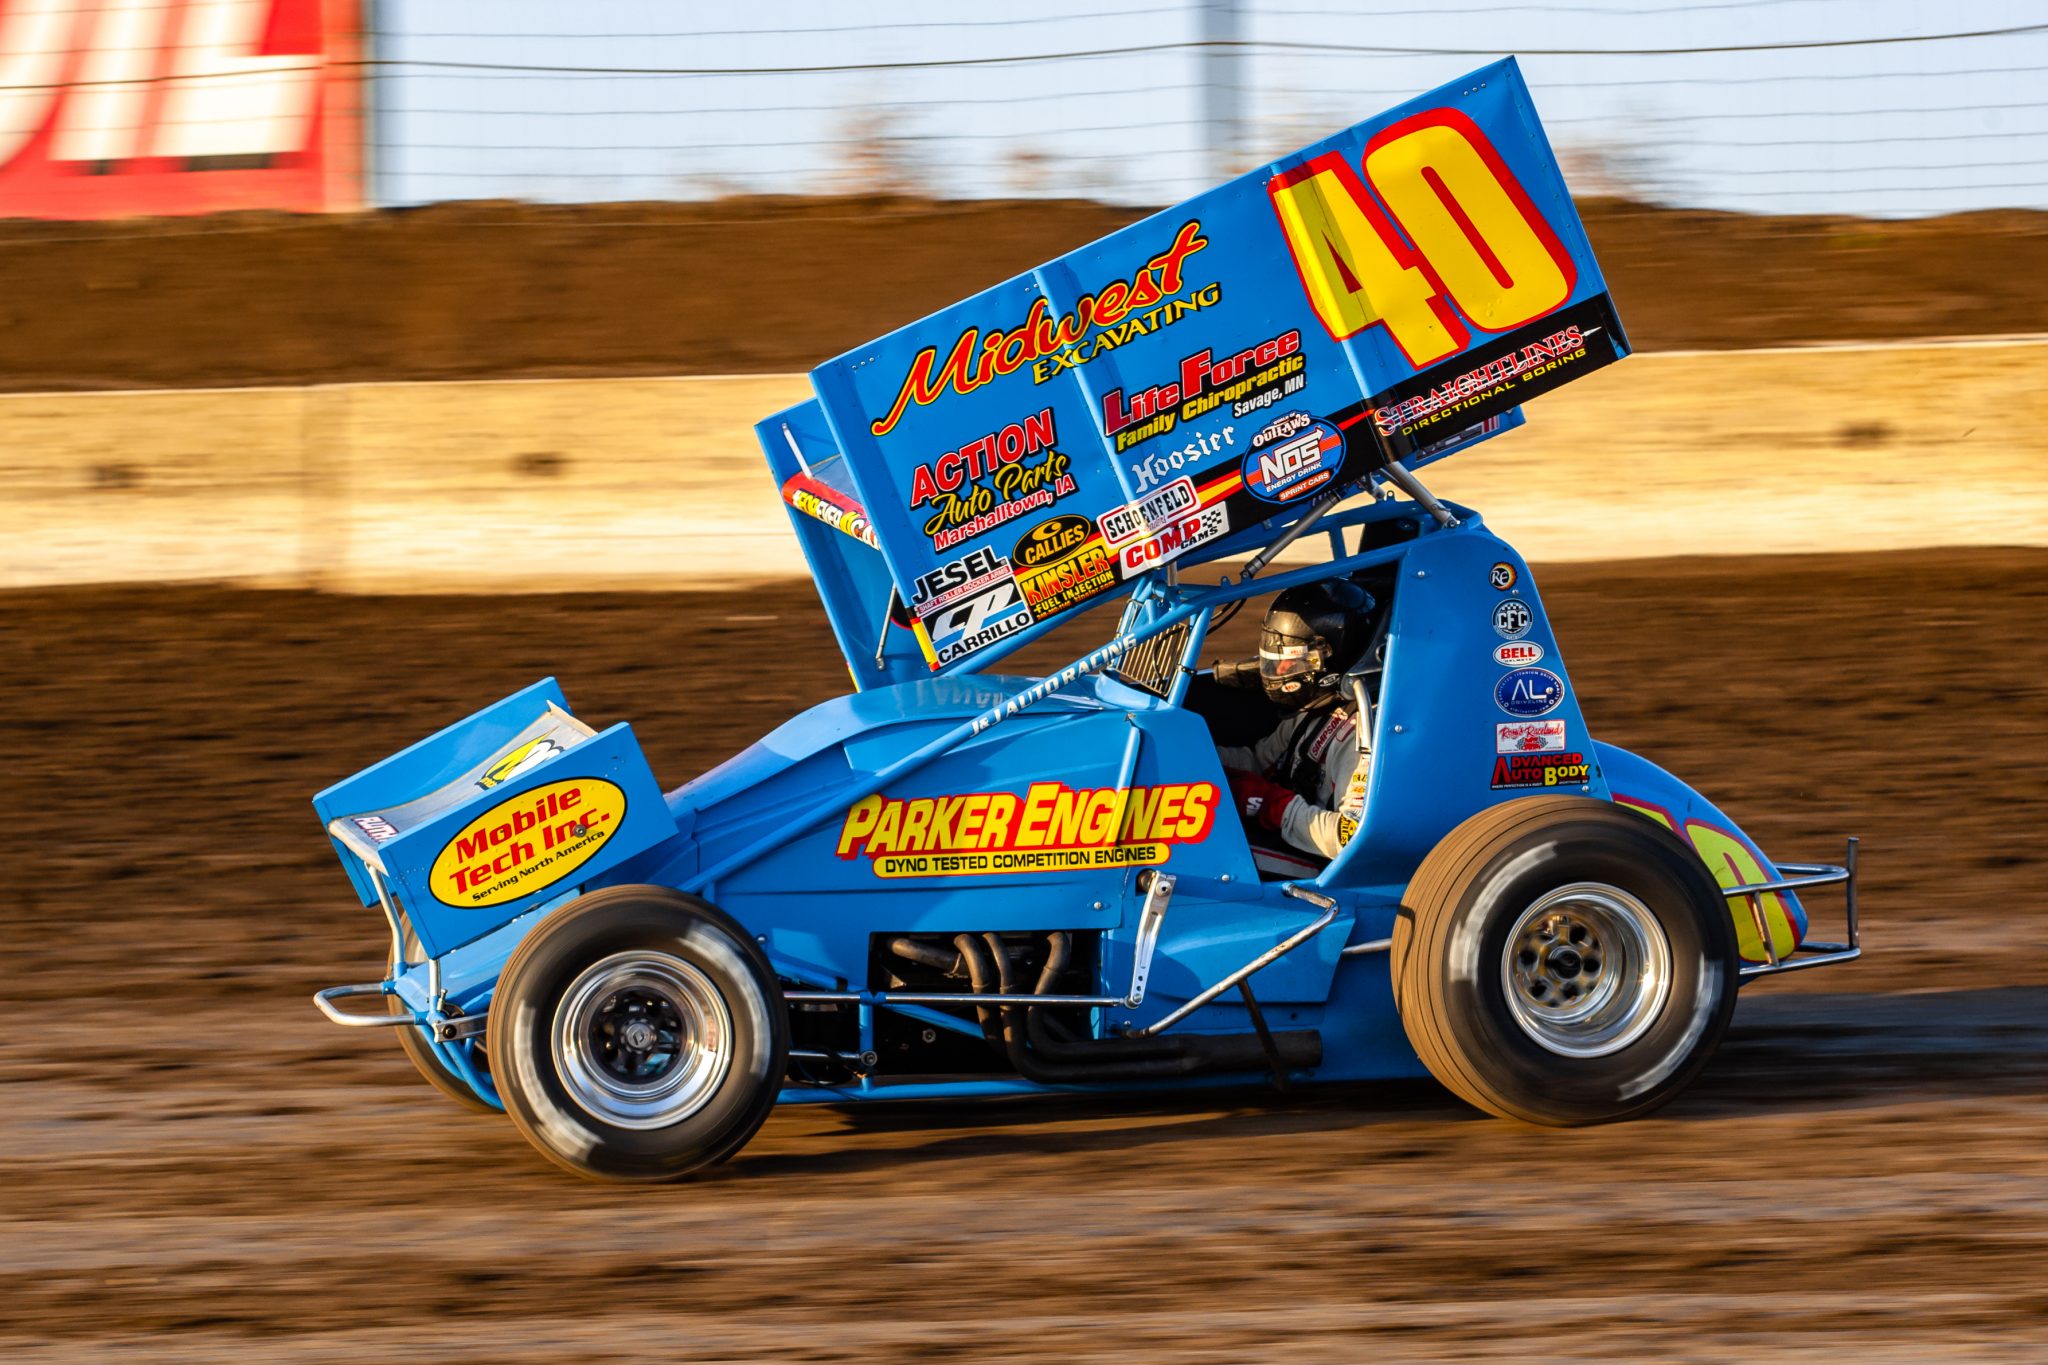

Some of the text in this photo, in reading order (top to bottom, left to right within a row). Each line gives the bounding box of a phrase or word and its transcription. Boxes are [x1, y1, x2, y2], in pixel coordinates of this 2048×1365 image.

[1266, 107, 1578, 371] 40
[872, 219, 1208, 436] Midwest
[1033, 281, 1222, 384] EXCAVATING
[1117, 354, 1304, 452] Family Chiropractic
[1233, 374, 1305, 417] Savage, MN
[1374, 325, 1586, 436] STRAIGHTLINES
[1402, 348, 1586, 436] DIRECTIONAL BORING
[910, 408, 1056, 508] ACTION
[1131, 424, 1236, 493] Hoosier
[1253, 413, 1311, 447] OUTLAWS
[1259, 427, 1326, 487] NOS
[924, 484, 991, 535] Auto
[994, 450, 1068, 500] Parts
[1266, 461, 1322, 492] ENERGY DRINK
[1279, 473, 1329, 499] SPRINT CARS
[934, 474, 1076, 551] Marshalltown, IA
[1105, 485, 1190, 538] SCHOENFELD
[1181, 526, 1219, 549] CAMS
[1024, 524, 1085, 566] CALLIES
[1125, 516, 1201, 569] COMP
[912, 548, 1002, 604] JESEL
[918, 566, 1009, 613] SHAFT ROLLER ROCKER ARMS
[1021, 548, 1111, 606] KINSLER
[1033, 596, 1061, 613] FUEL
[1062, 571, 1115, 600] INJECTION
[938, 612, 1030, 663] CARRILLO
[1498, 610, 1528, 630] CFC
[1006, 677, 1059, 718] AUTO
[1062, 633, 1137, 687] RACING
[1500, 647, 1536, 659] BELL
[1312, 717, 1342, 756] SIMPSON
[1544, 764, 1590, 786] BODY
[455, 787, 582, 864] Mobile
[836, 782, 1222, 858] PARKER ENGINES
[449, 808, 611, 895] Tech Inc.
[472, 830, 605, 902] Serving North America
[885, 847, 1156, 873] DYNO TESTED COMPETITION ENGINES
